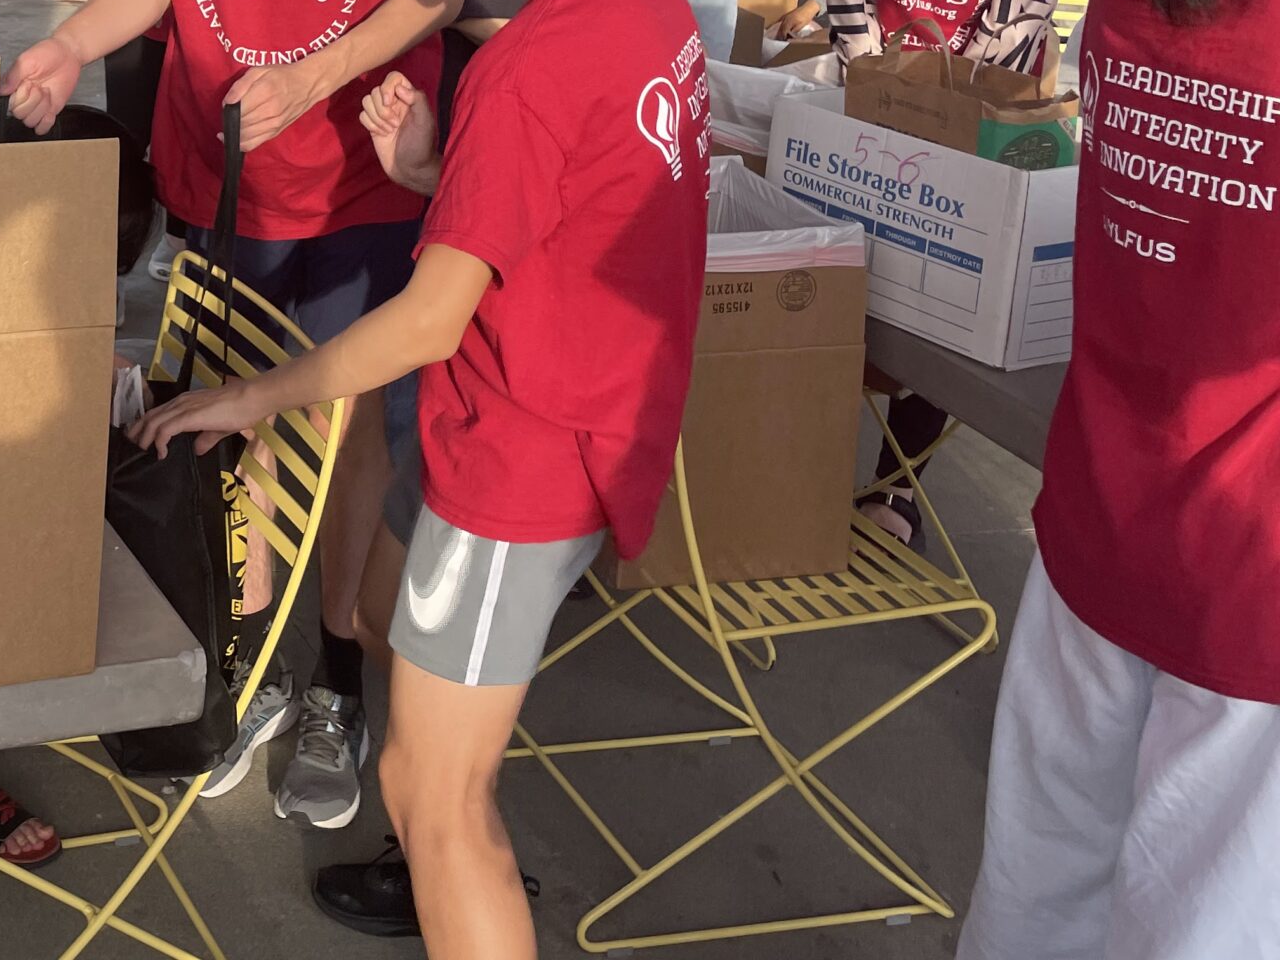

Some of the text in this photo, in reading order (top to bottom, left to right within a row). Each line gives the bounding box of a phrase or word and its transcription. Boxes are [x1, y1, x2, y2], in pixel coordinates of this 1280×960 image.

[1104, 101, 1264, 165] INTEGRITY
[783, 168, 955, 240] COMMERCIAL STRENGTH
[785, 137, 965, 219] File Storage Box
[1100, 140, 1277, 211] INNOVATION
[885, 229, 916, 247] THROUGH
[929, 246, 981, 271] DESTROY DATE
